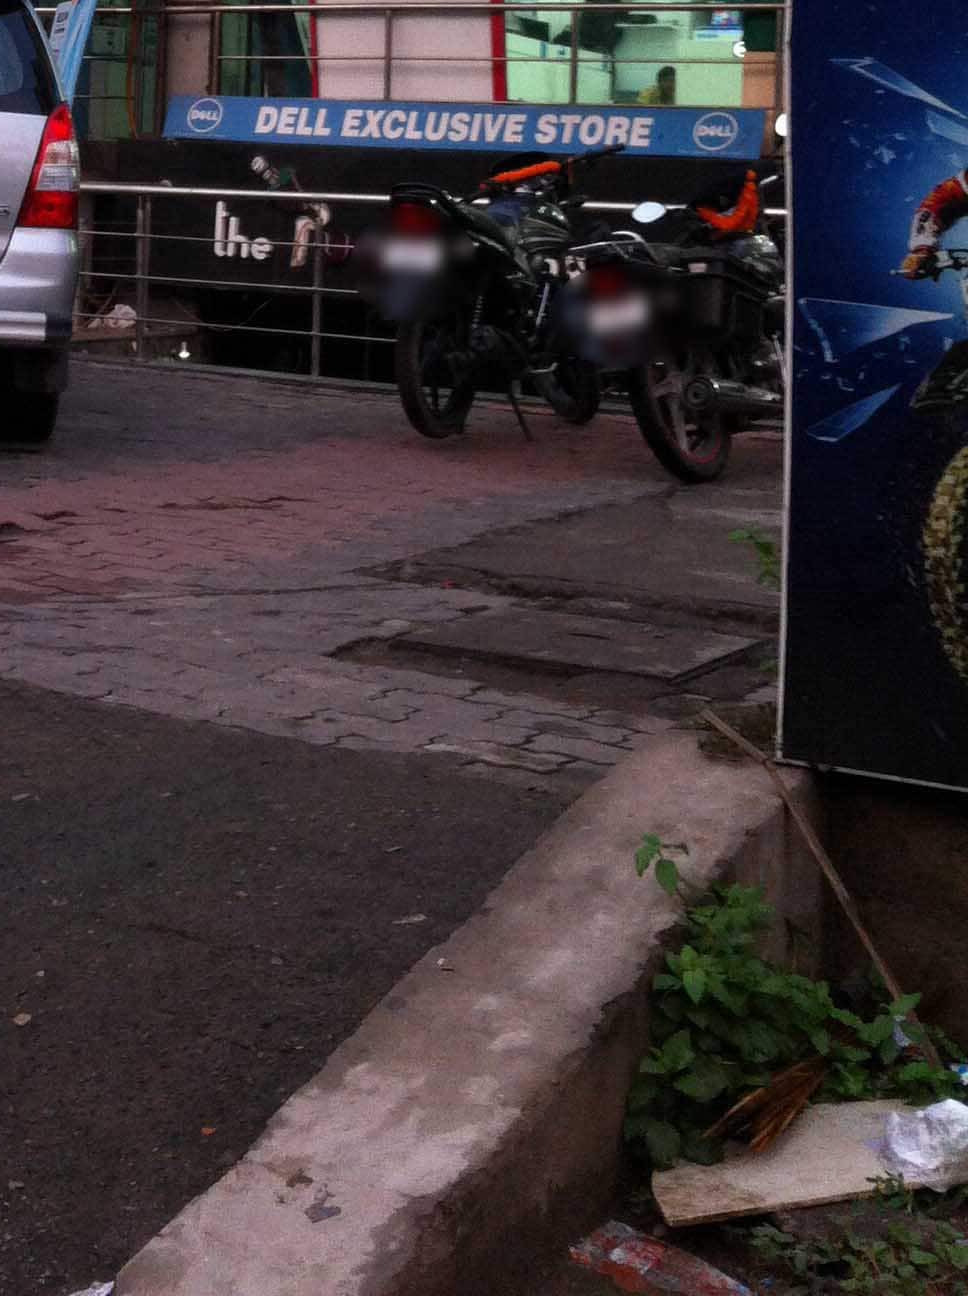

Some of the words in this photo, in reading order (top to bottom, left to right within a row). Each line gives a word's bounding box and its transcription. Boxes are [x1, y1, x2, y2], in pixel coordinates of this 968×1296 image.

[190, 108, 219, 122] DELL
[254, 105, 331, 137] DELL
[340, 109, 527, 144] EXCLUSIVE
[535, 114, 655, 148] STORE
[214, 200, 274, 260] the
